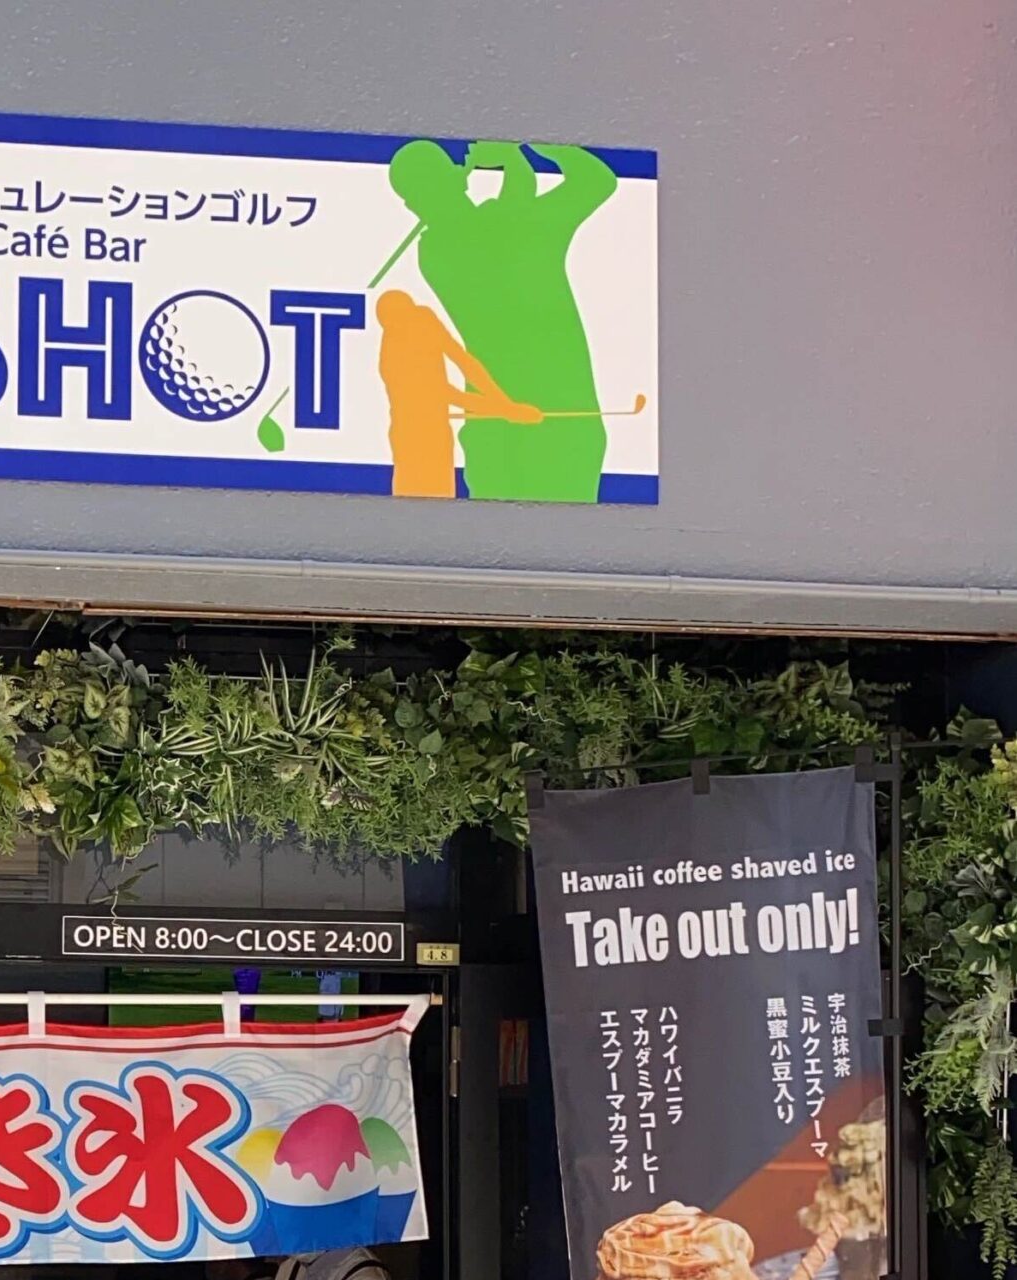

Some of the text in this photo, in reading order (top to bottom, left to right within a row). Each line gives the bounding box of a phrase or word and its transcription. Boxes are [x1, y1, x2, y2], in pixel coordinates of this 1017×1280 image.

[83, 228, 147, 264] Bar
[561, 849, 856, 895] Hawaii coffee shaved ice
[73, 924, 146, 950] OPEN
[324, 930, 393, 953] 24:00
[565, 888, 861, 969] Take out only!
[658, 1004, 684, 1125] ハワイバニラ
[766, 996, 795, 1125] 黒蜜小豆入り
[800, 994, 829, 1160] ミルクエスプーマ
[827, 992, 851, 1079] 宇治抹茶
[599, 1010, 632, 1194] エスプーマカラメル
[630, 1007, 660, 1194] マカダミアコーヒー
